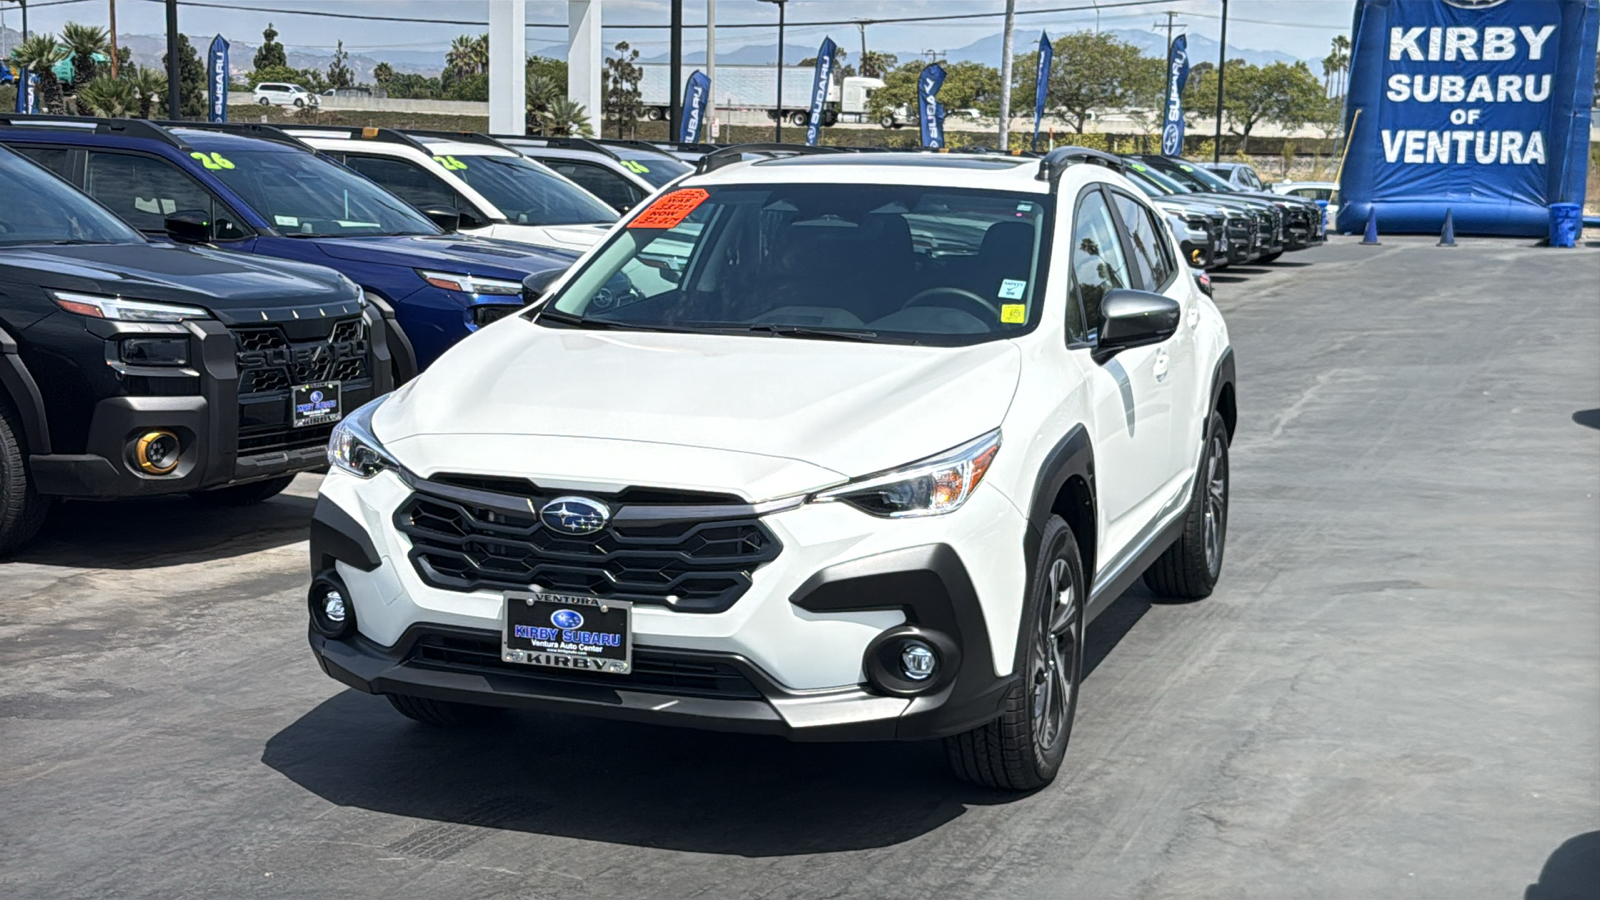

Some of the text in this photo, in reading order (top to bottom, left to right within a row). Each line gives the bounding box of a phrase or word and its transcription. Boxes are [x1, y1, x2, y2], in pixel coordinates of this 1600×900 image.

[1388, 25, 1556, 62] KIRBY
[214, 51, 225, 115] SUBARU
[811, 55, 830, 125] SUBARU
[1386, 74, 1552, 103] SUBARU
[685, 86, 703, 143] UBARU
[1449, 109, 1481, 126] OF
[1381, 129, 1547, 165] VENTURA
[190, 152, 236, 170] 26
[432, 155, 468, 170] 26
[620, 160, 650, 173] 26
[535, 594, 600, 606] VENTURA
[515, 625, 621, 646] KIRBY SUBARU
[531, 639, 604, 653] Ventura Auto Center
[527, 653, 608, 670] KIRBY
